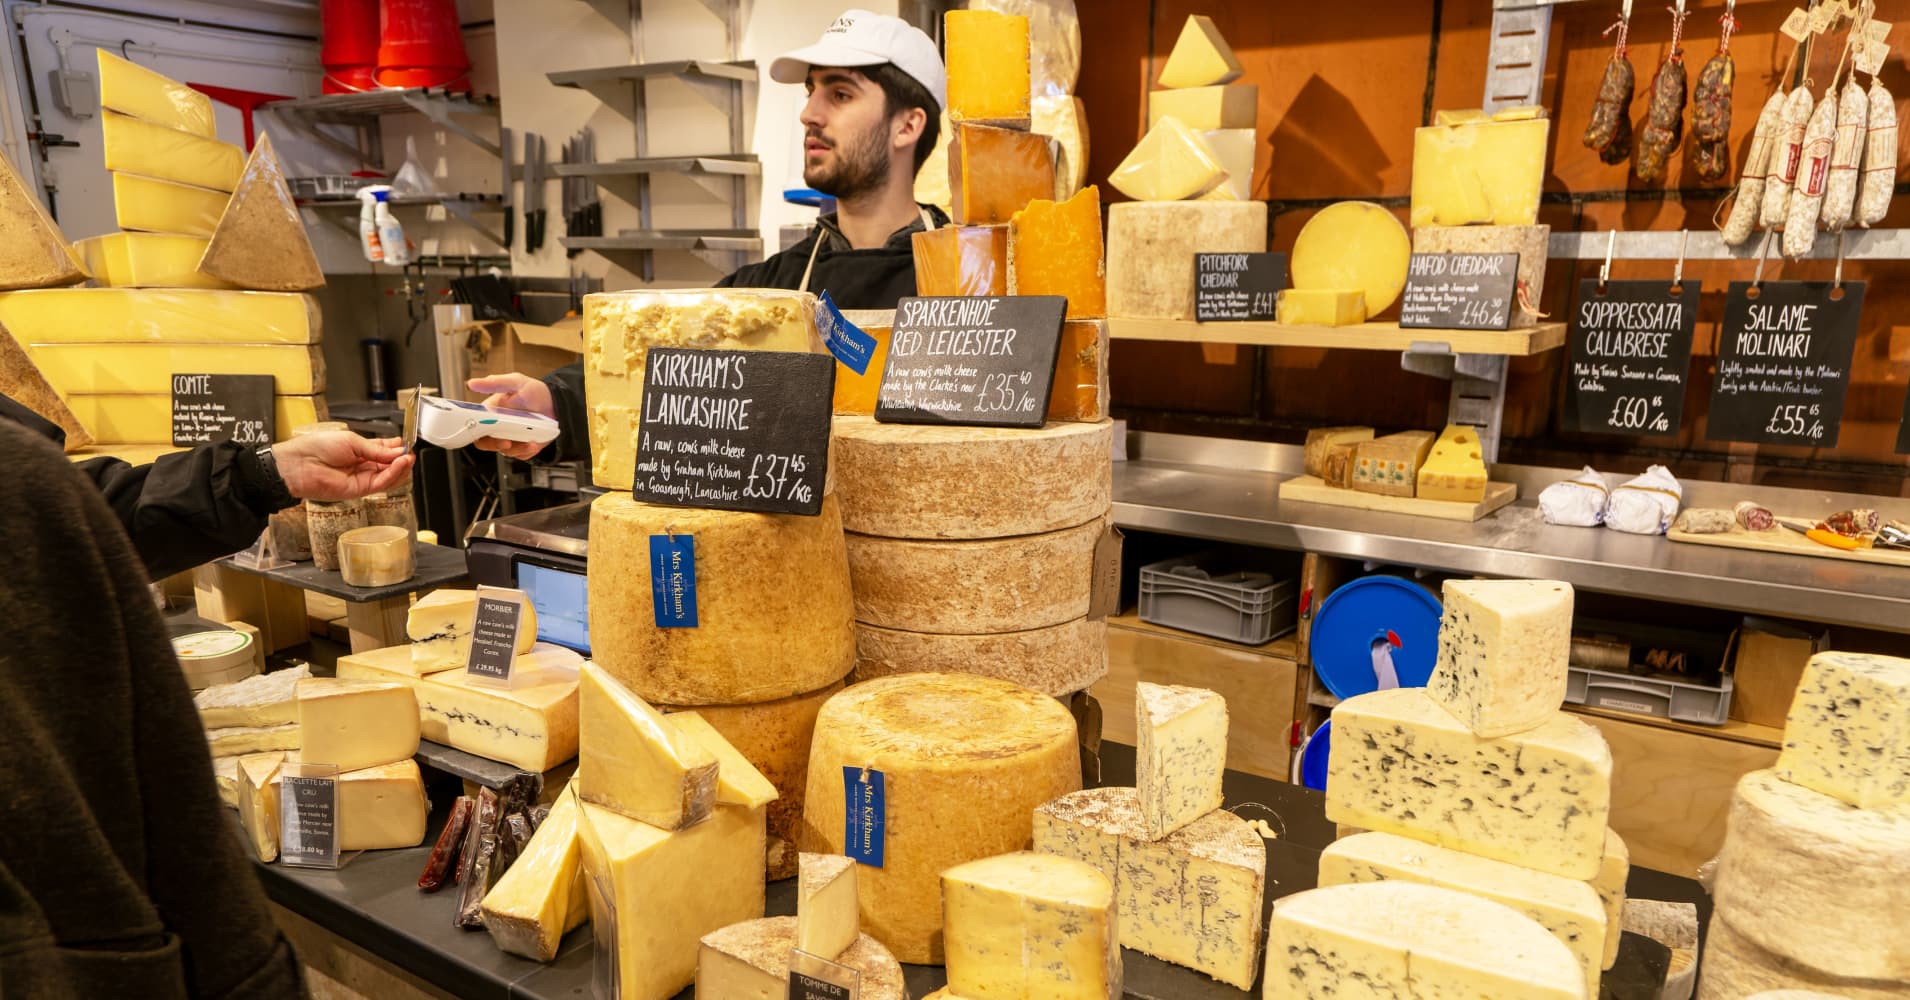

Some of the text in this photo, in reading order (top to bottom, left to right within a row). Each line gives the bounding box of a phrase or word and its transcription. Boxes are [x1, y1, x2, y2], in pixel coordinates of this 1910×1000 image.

[1200, 254, 1249, 271] PITCHFORK
[1410, 255, 1504, 276] HAFOD CHEDDAR
[1200, 272, 1239, 288] CHEDDAR
[900, 298, 1000, 328] SPARKENHOE
[1251, 292, 1273, 315] £41
[1459, 301, 1488, 325] £46
[1580, 301, 1682, 330] SOPPRESSATA
[1744, 304, 1818, 331] SALAME
[834, 322, 866, 354] Kirkham's
[890, 330, 923, 356] RED
[927, 328, 1017, 356] LEICESTER
[1586, 331, 1671, 358] CALABRESE
[1736, 332, 1811, 358] MOLINARI
[651, 353, 747, 390] KIRKHAM'S
[887, 361, 895, 377] A
[934, 364, 953, 377] milk
[954, 364, 978, 377] cheese
[1591, 364, 1600, 380] by
[1720, 360, 1743, 378] Lightly
[1766, 364, 1778, 376] and
[1794, 366, 1803, 379] by
[1804, 366, 1815, 377] the
[903, 379, 913, 398] by
[915, 378, 927, 391] the
[930, 378, 958, 393] Clarke's
[974, 371, 1036, 412] £35 40 /KG
[645, 393, 753, 431] LANCASHIRE
[1608, 396, 1648, 428] £60
[1809, 403, 1820, 416] 65
[231, 420, 255, 443] £38
[642, 431, 746, 458] A raw, cow's milk cheese
[637, 458, 741, 481] made by Graham Kirkham
[743, 453, 813, 503] £37 45 /KG
[636, 479, 645, 490] in
[672, 551, 686, 619] Mrs Kirkham's
[485, 602, 513, 614] MORBIER
[863, 783, 874, 855] Mrs Kirkham's
[799, 975, 842, 997] TOMME DE
